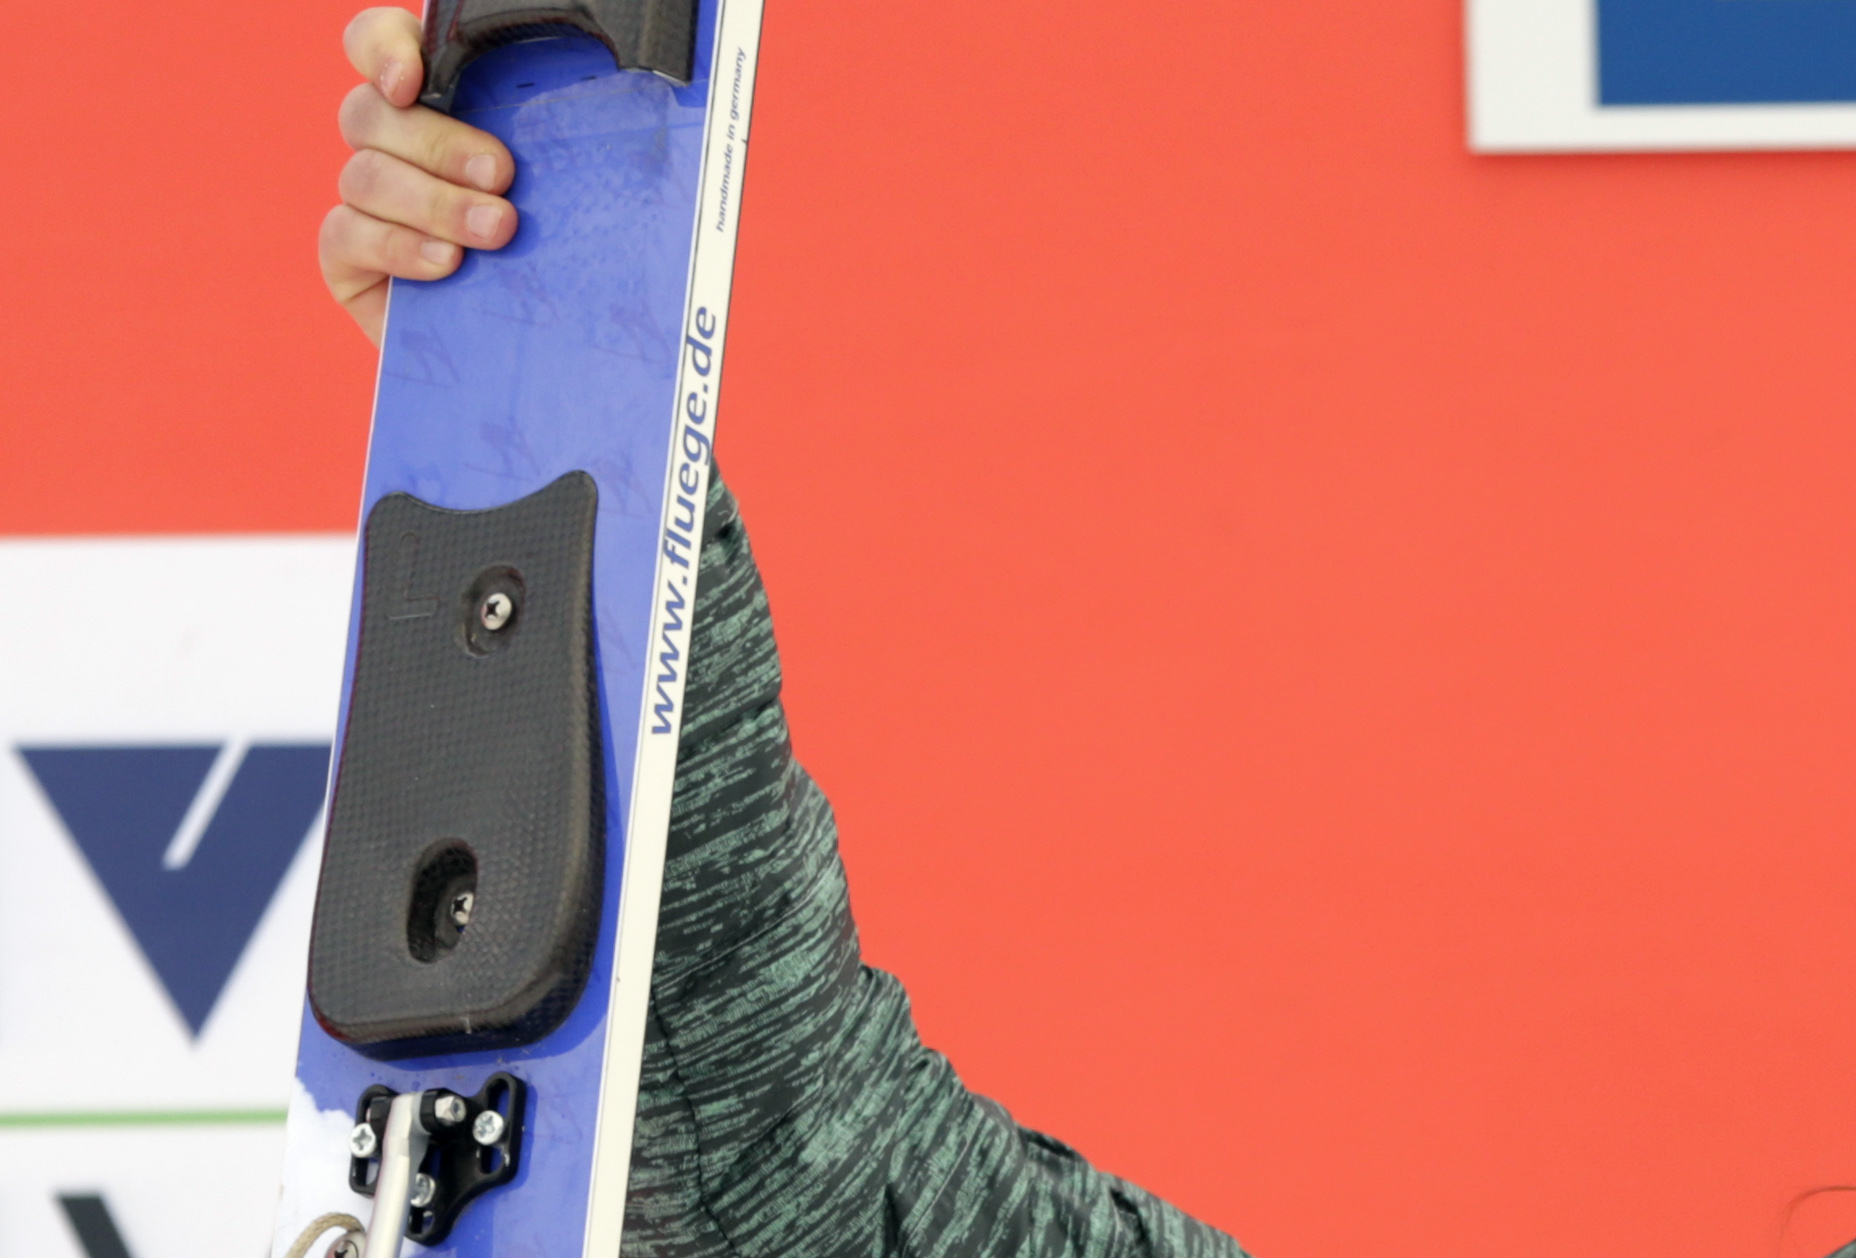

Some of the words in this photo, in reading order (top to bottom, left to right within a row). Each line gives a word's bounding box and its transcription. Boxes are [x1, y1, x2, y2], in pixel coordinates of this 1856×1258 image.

[729, 46, 747, 122] germany
[725, 123, 736, 141] in
[715, 143, 734, 233] handmade
[651, 306, 716, 735] www.fluege.de
